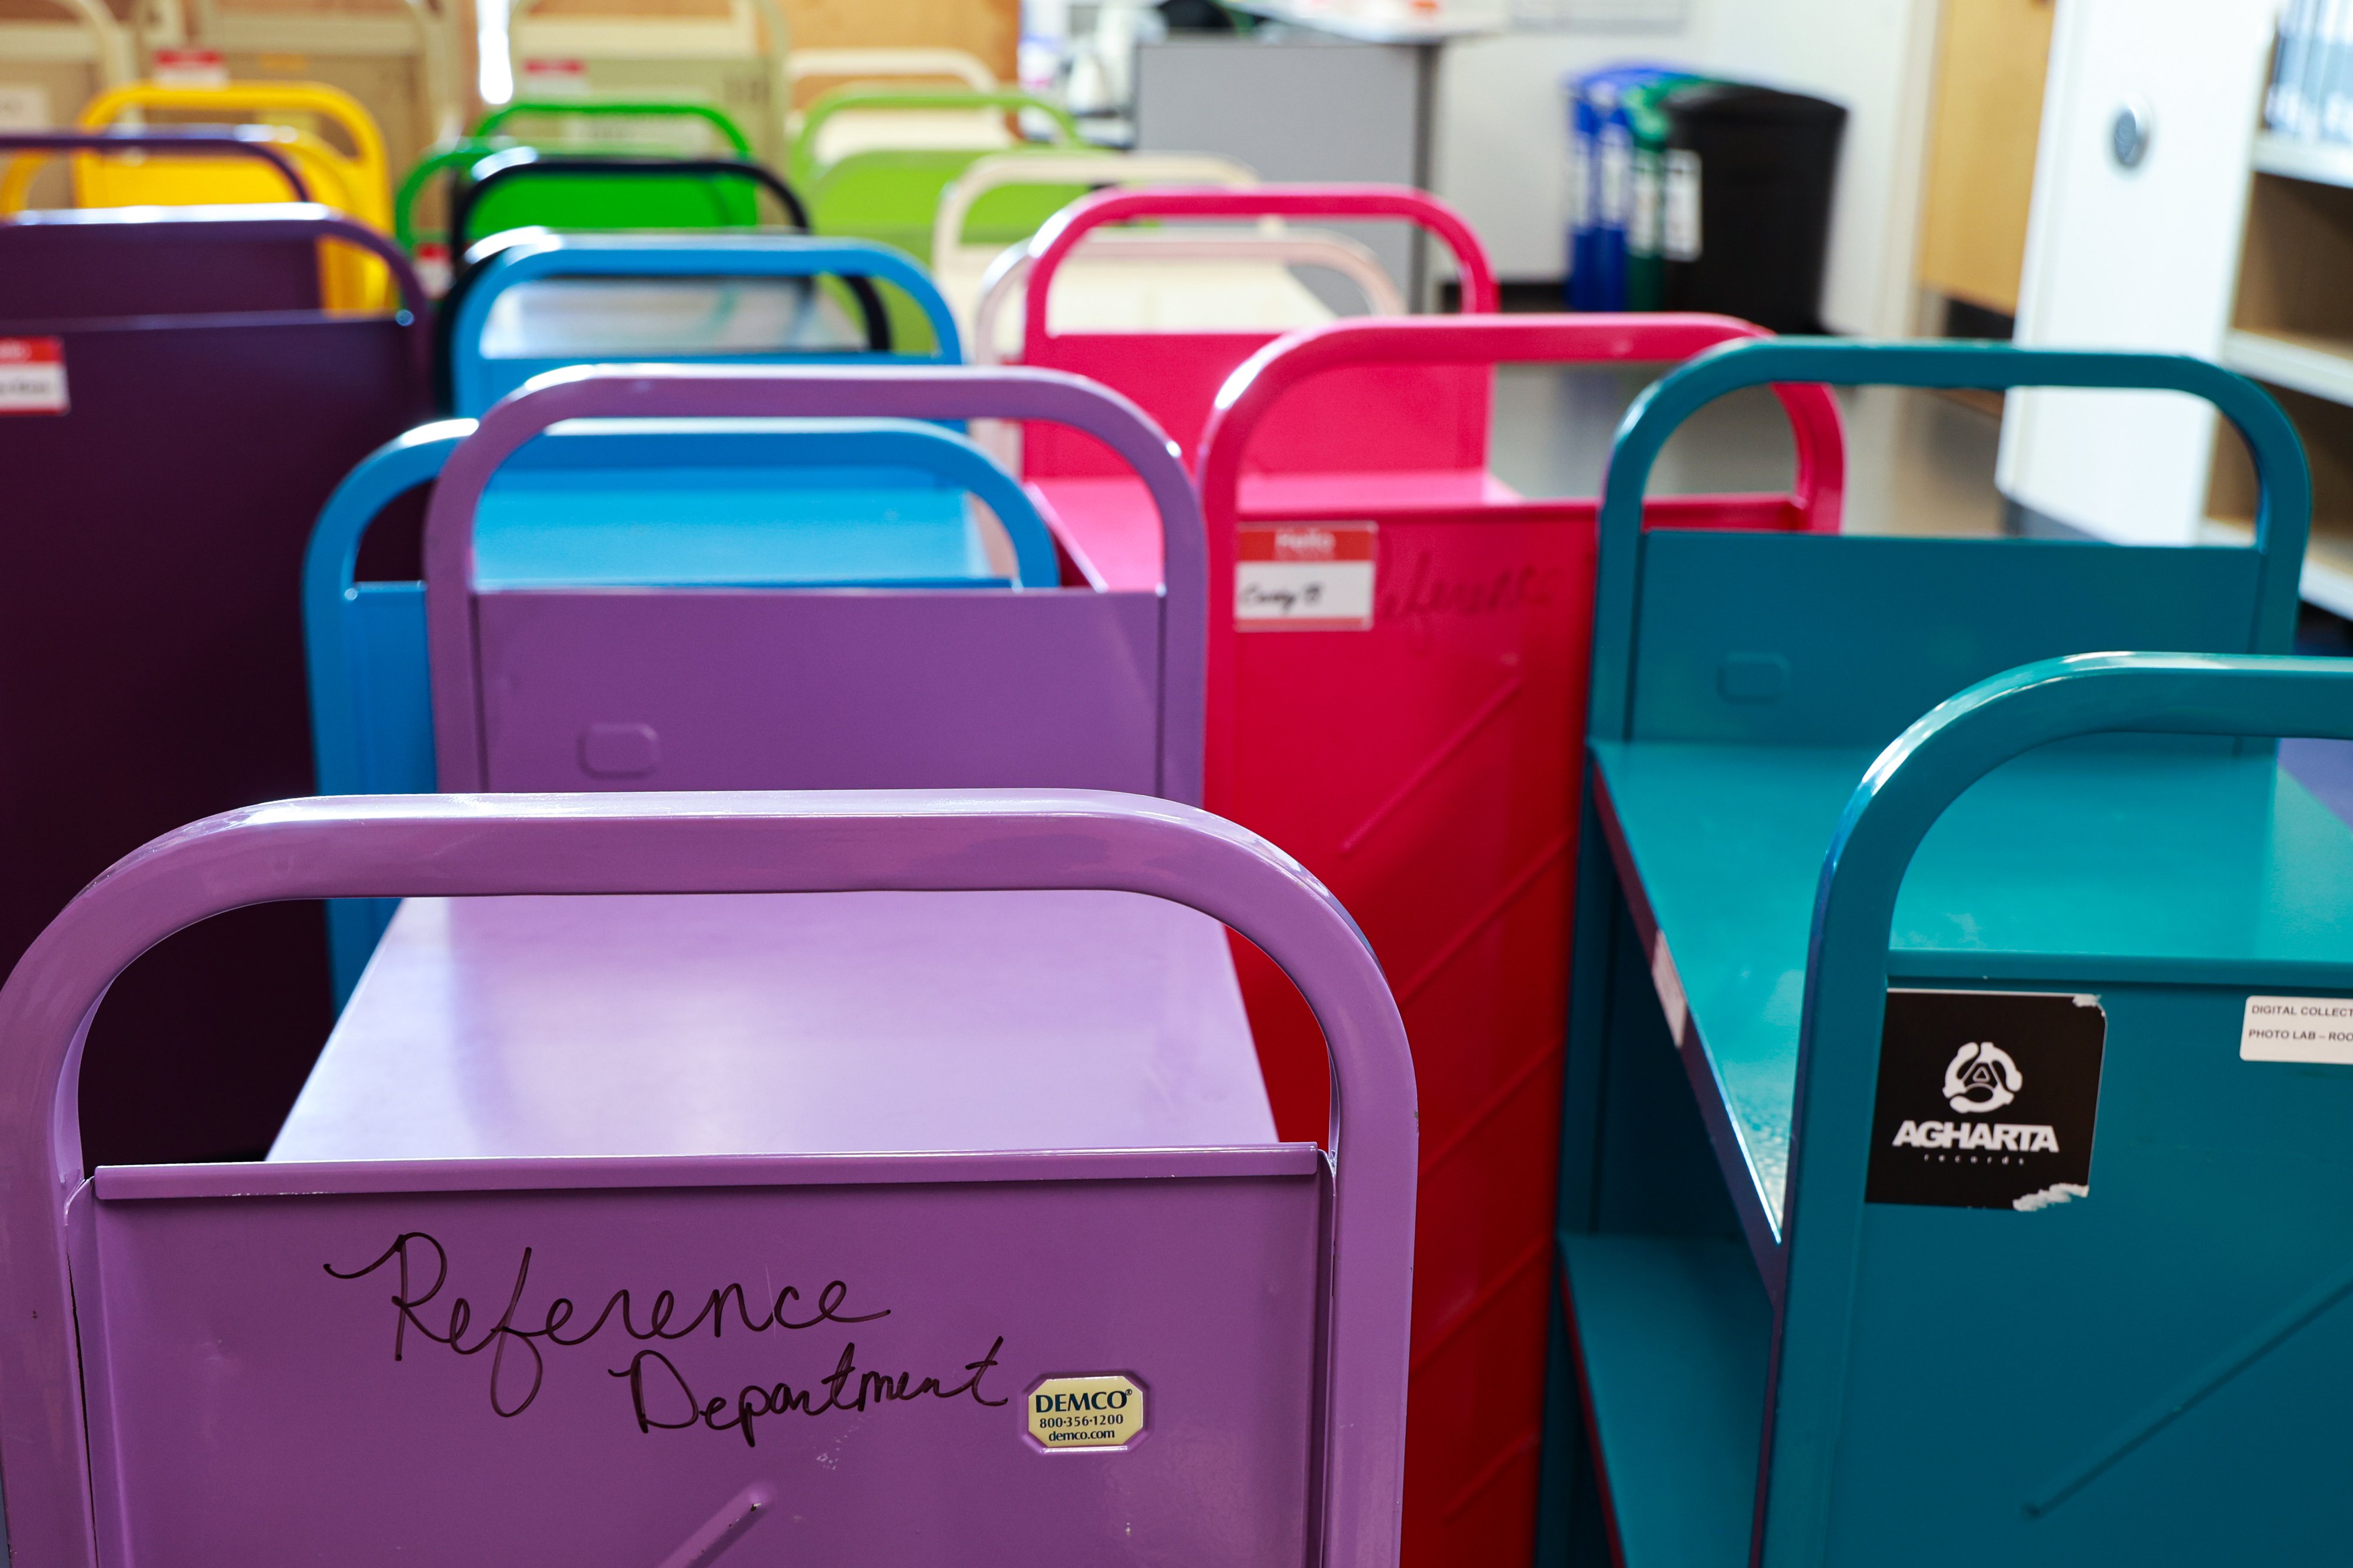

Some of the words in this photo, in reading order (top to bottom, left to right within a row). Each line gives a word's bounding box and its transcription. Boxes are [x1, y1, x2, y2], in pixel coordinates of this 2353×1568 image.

[2251, 1005, 2297, 1016] DIGITAL
[2301, 1006, 2353, 1017] COLLECT
[2248, 1029, 2290, 1039] PHOTO
[2292, 1030, 2316, 1040] LAB
[2328, 1031, 2353, 1042] ROO
[1892, 1120, 2059, 1153] AGHARTA
[1924, 1153, 2024, 1166] records
[323, 1231, 891, 1418] Reference
[607, 1336, 1008, 1447] Department
[1048, 1430, 1115, 1442] demco.com
